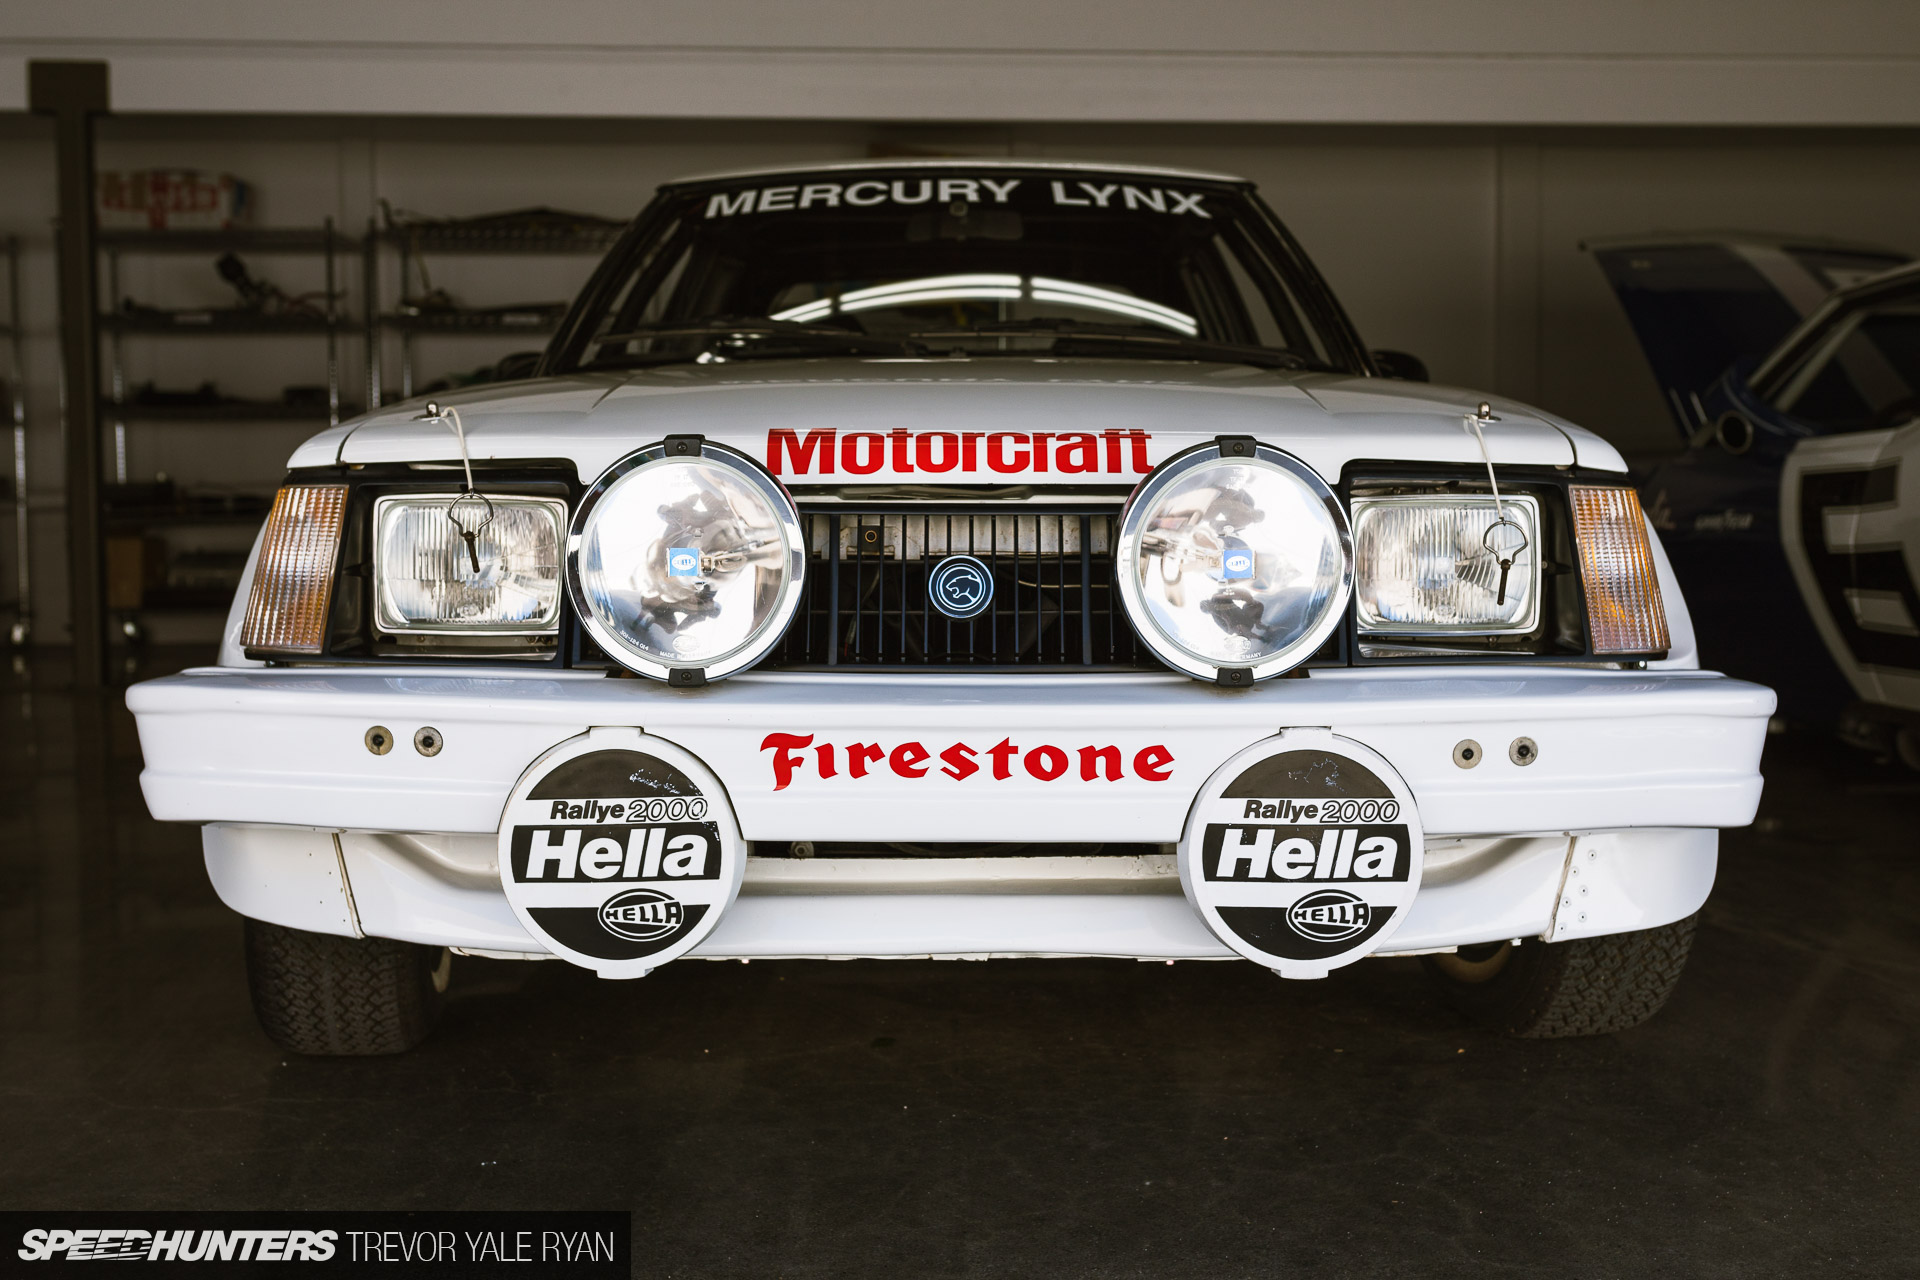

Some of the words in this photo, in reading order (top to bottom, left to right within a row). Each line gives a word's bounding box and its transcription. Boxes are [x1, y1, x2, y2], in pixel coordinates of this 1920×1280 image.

[704, 178, 1021, 219] MERCURY
[1051, 180, 1212, 219] LYNX
[766, 427, 1155, 476] Motorcraft
[759, 732, 1176, 792] Firestone
[550, 800, 625, 823] Rallye
[626, 798, 708, 822] 2000
[1243, 799, 1319, 823] Rallye
[1319, 799, 1400, 823] 2000
[525, 827, 709, 880] Hella
[1215, 828, 1399, 880] Hella
[605, 901, 682, 925] HELLA
[1293, 902, 1369, 926] HELLA
